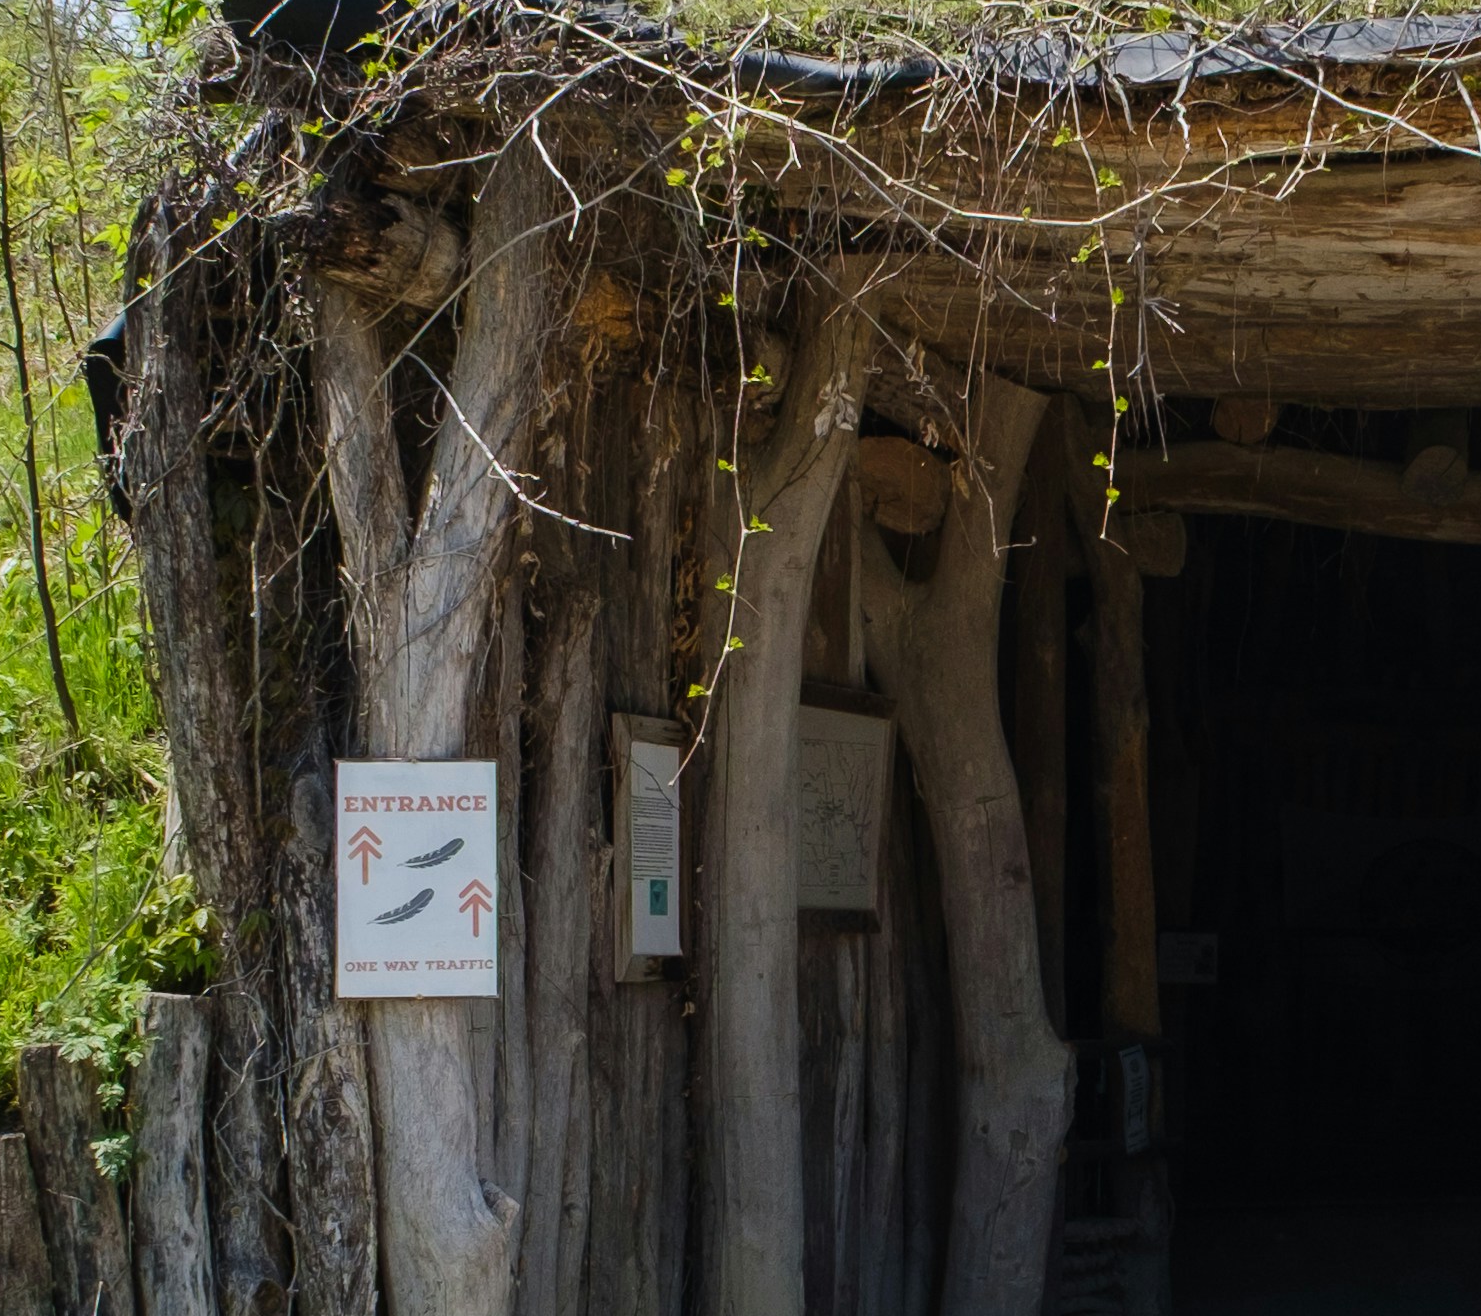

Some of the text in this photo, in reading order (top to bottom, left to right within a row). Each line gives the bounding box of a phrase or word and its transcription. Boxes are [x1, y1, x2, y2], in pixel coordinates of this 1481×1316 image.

[344, 795, 488, 813] ENTRANCE
[344, 959, 494, 972] ONE WAY TRAFFIC
